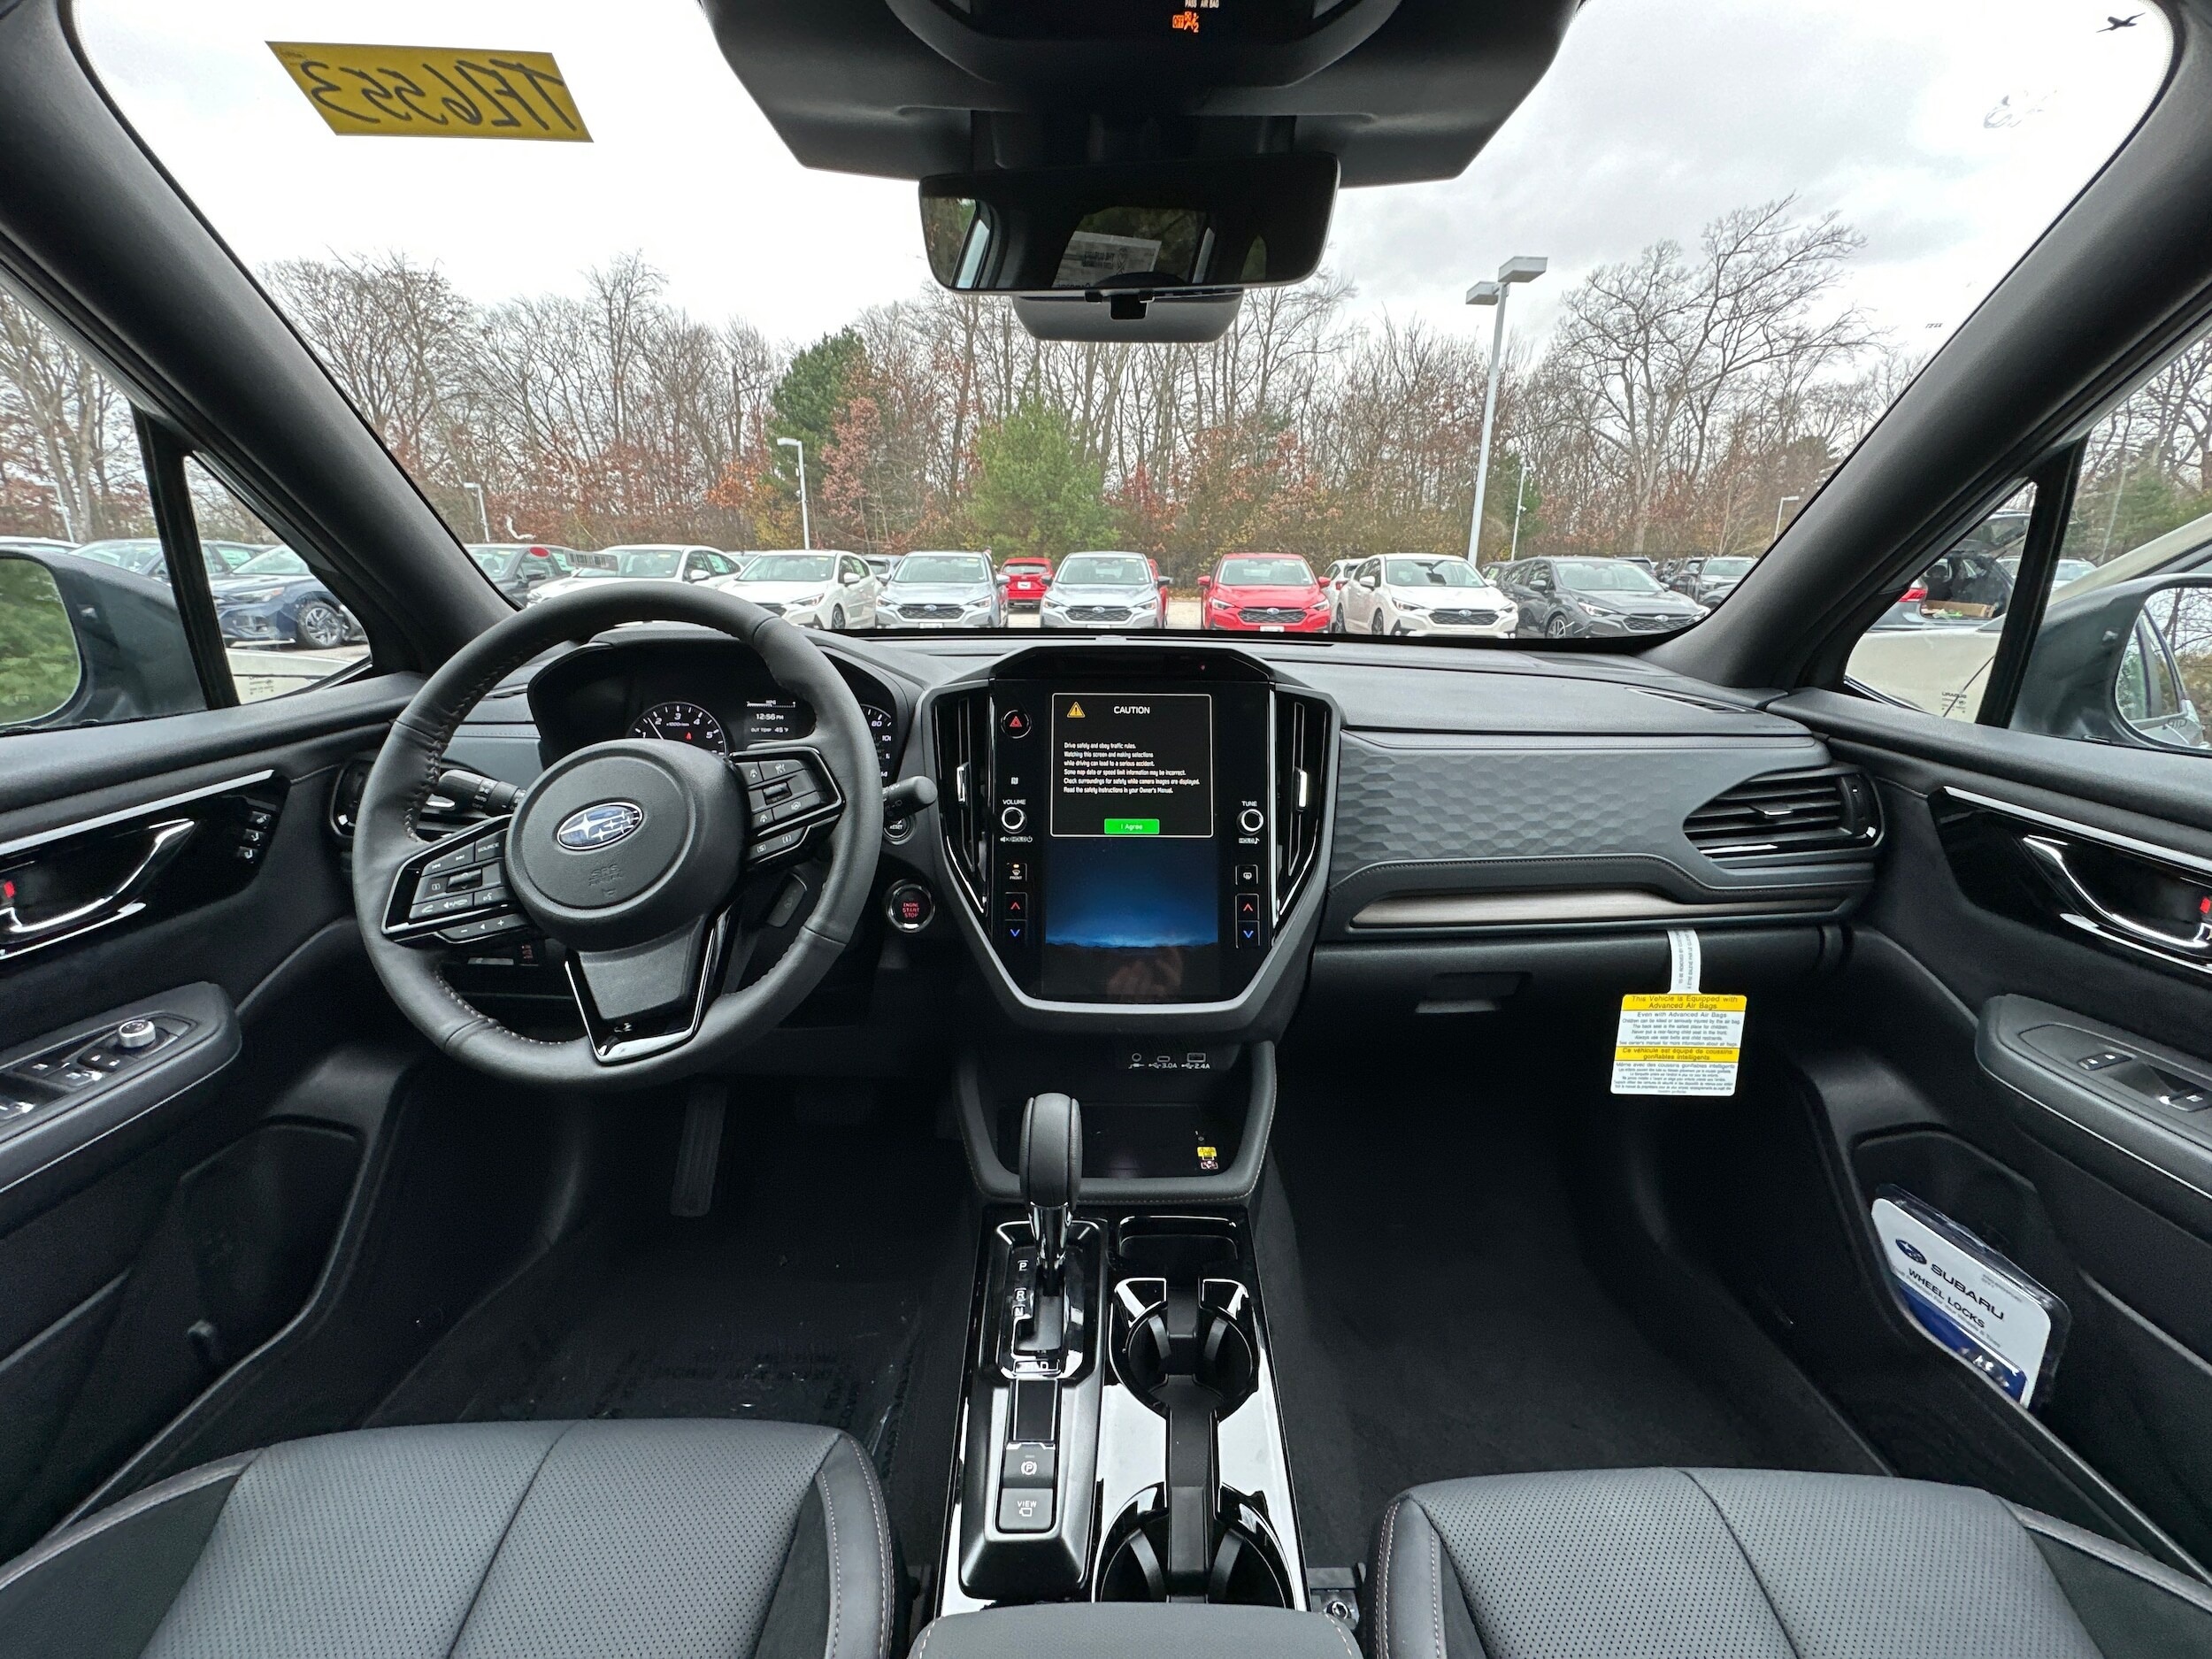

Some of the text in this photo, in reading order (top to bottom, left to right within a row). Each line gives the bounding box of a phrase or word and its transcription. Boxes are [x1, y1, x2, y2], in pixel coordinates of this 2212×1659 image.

[1114, 706, 1151, 714] CAUTION
[478, 842, 499, 853] SOURCE
[1018, 1262, 1028, 1272] P
[1016, 1290, 1026, 1301] R
[1931, 1264, 2004, 1320] SUBARU
[1909, 1268, 1944, 1300] WHEEL
[1947, 1297, 1985, 1328] LOCKS
[1014, 1307, 1024, 1317] N
